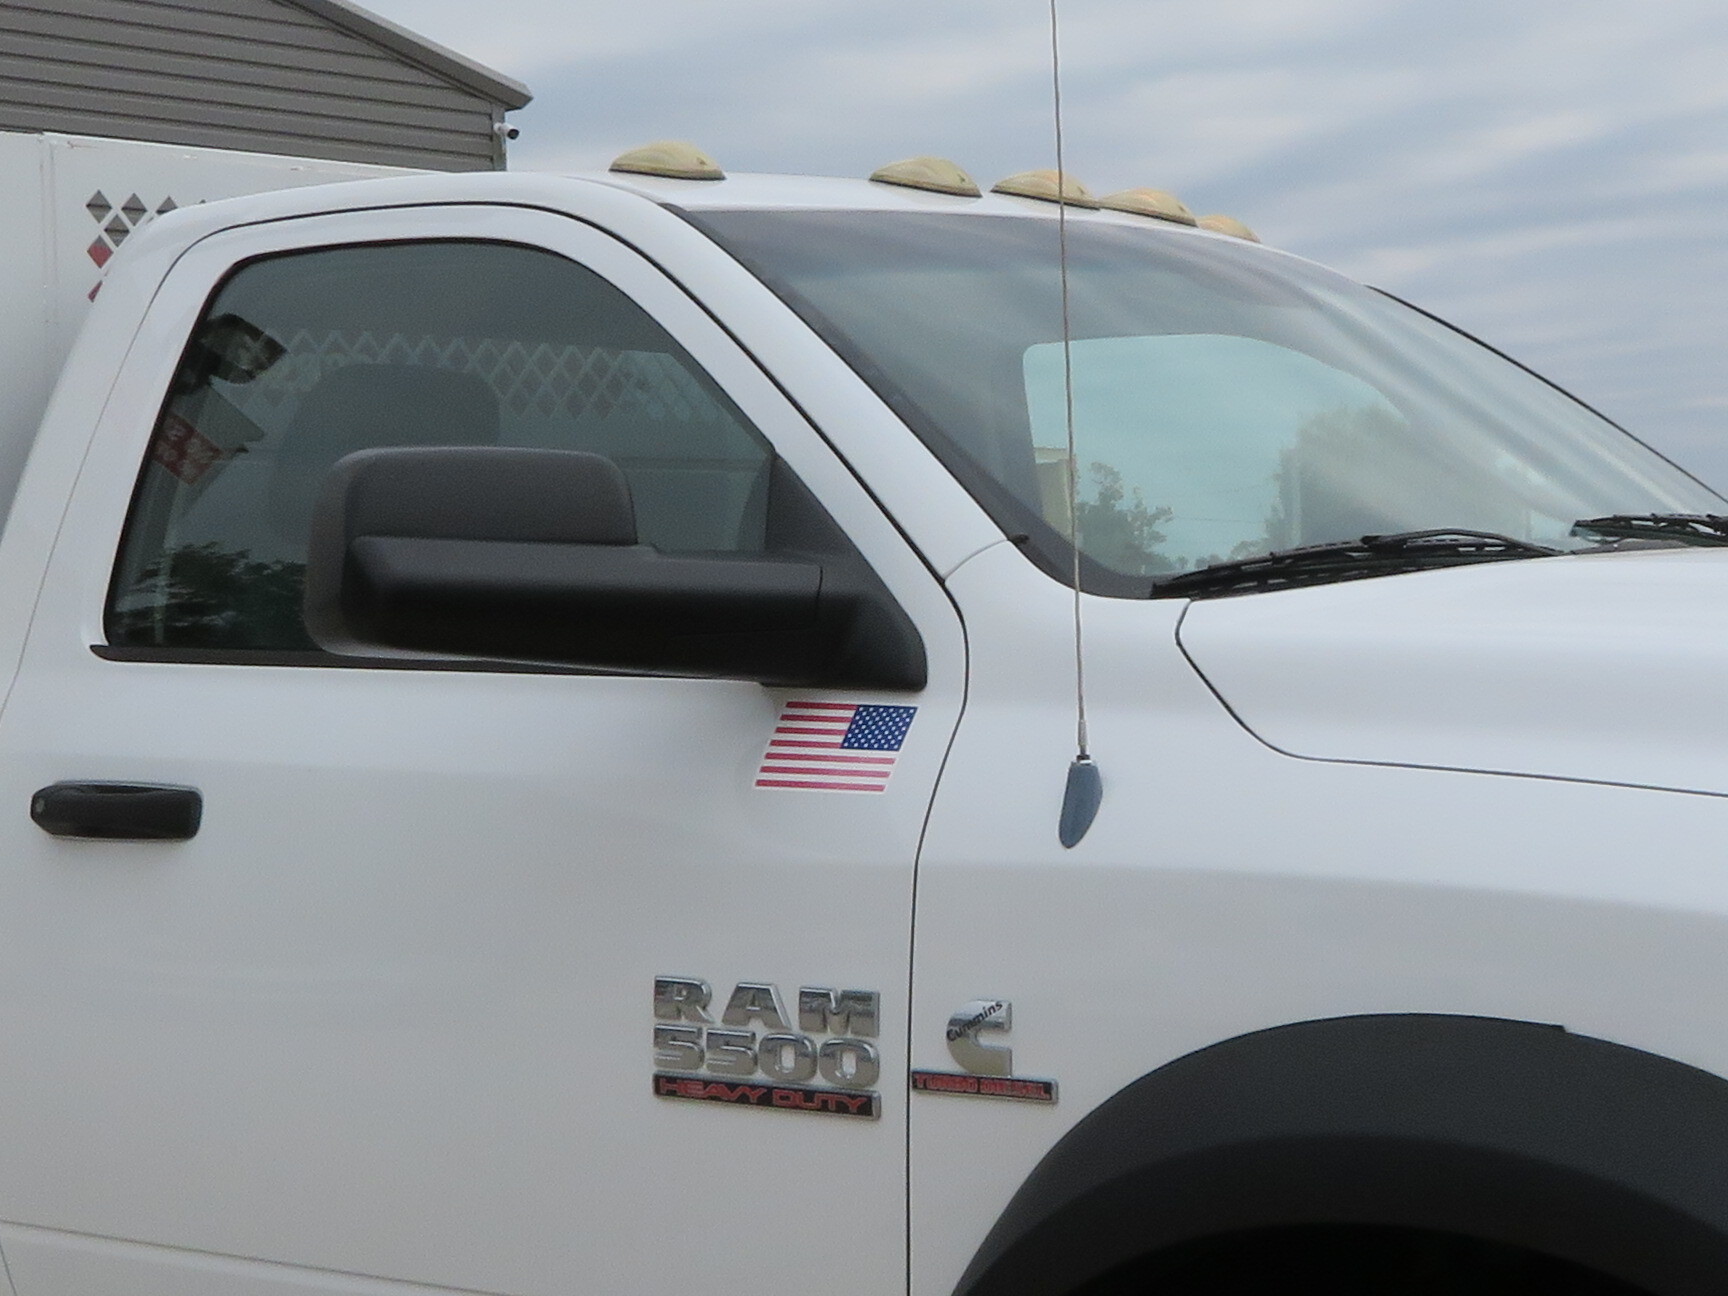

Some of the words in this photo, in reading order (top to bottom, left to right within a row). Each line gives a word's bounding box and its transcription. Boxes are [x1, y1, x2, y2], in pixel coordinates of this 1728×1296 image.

[654, 975, 881, 1039] RAM
[946, 1001, 1003, 1042] Cummins
[653, 1023, 881, 1090] 5500
[658, 1074, 769, 1106] HEAVY
[771, 1086, 870, 1115] DUTY
